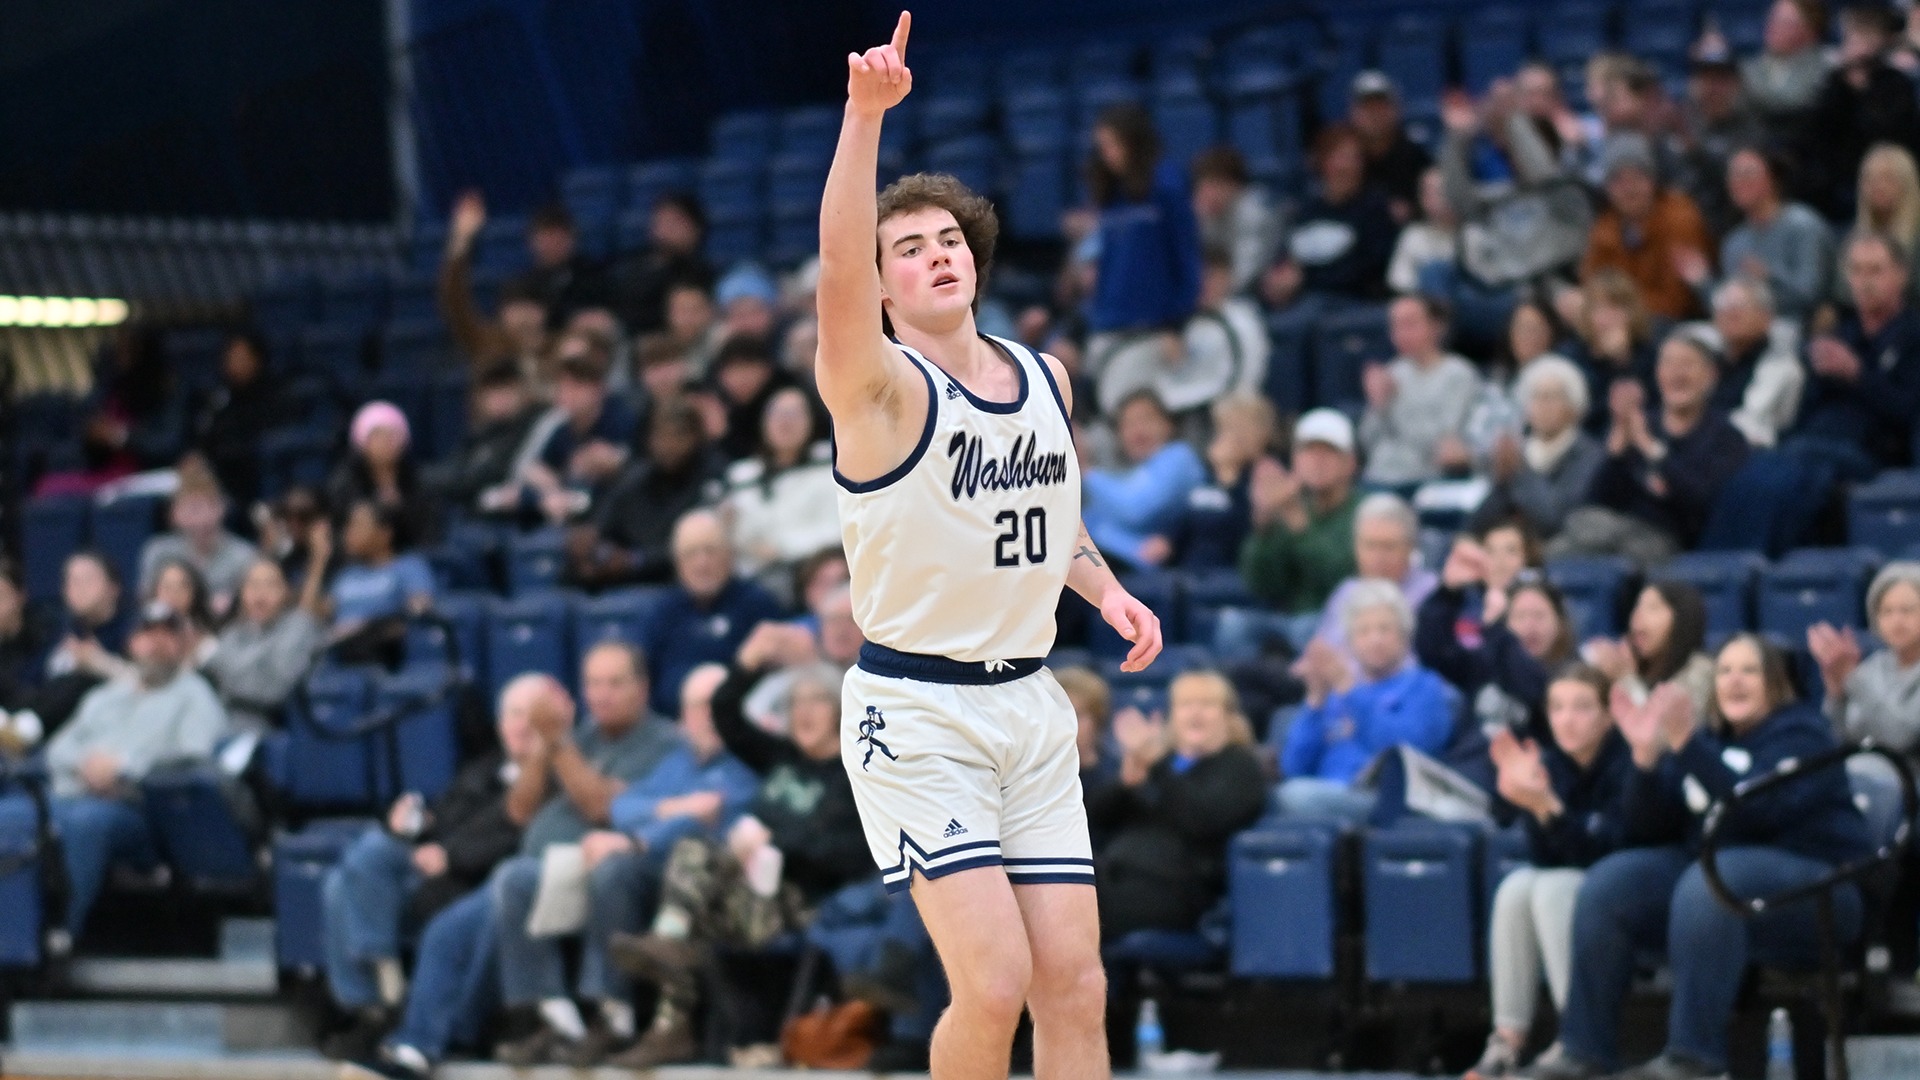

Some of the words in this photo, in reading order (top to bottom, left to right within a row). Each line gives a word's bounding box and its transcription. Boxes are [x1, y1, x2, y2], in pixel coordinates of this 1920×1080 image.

[948, 430, 1067, 500] Washburn
[995, 507, 1047, 567] 20
[943, 828, 968, 838] adidas
